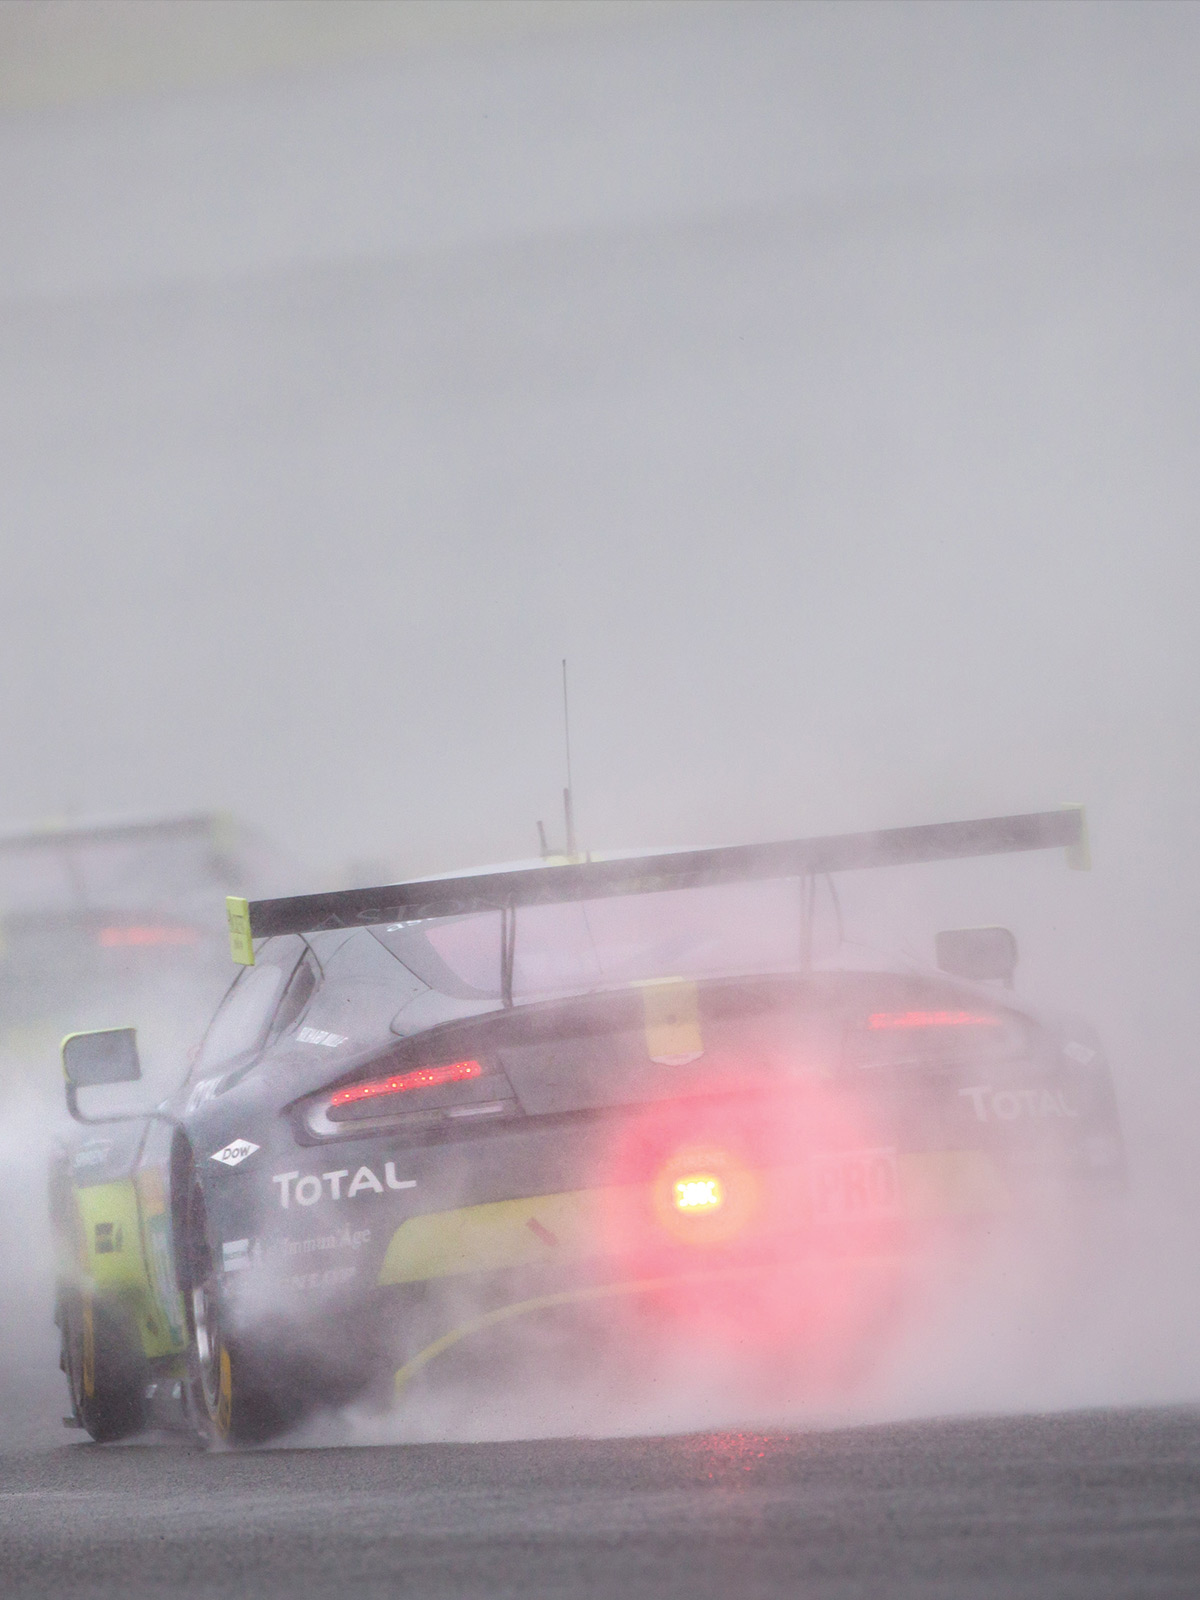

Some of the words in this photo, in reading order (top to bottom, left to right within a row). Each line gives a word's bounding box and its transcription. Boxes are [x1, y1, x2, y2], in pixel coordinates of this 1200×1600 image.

[958, 1084, 1079, 1121] TOTAL
[272, 1161, 418, 1210] TOTAL
[817, 1157, 895, 1213] PRO
